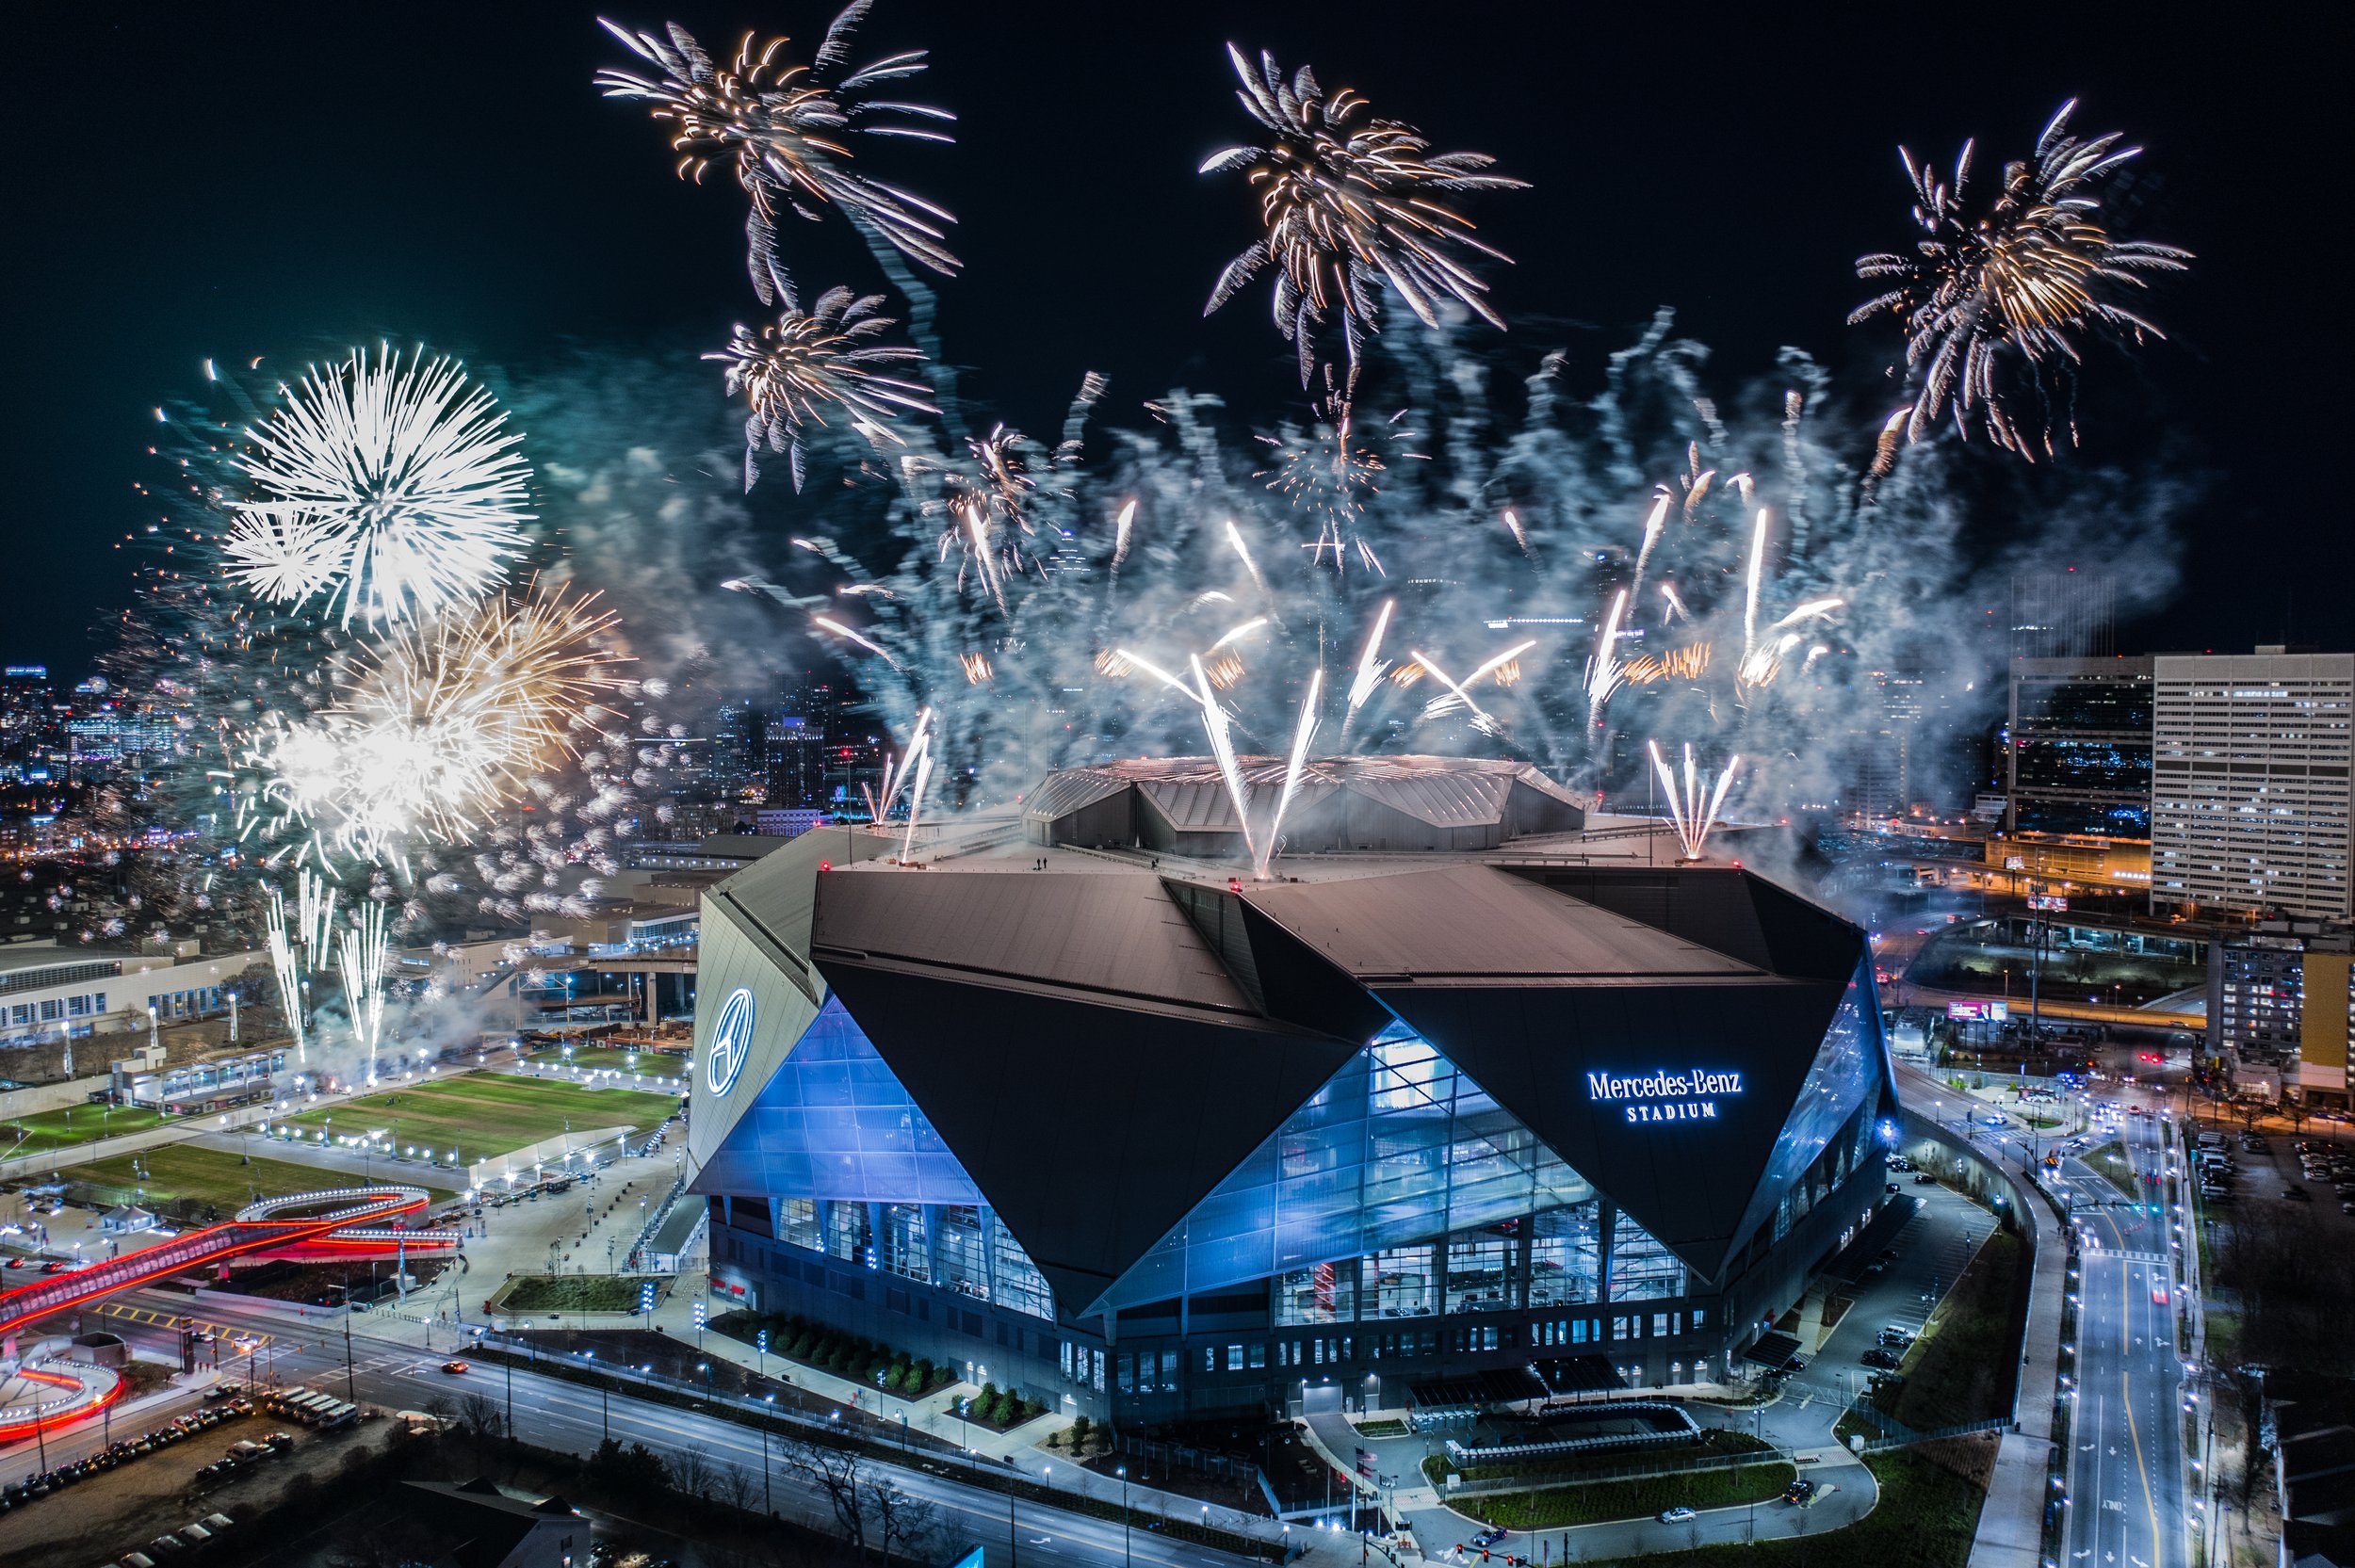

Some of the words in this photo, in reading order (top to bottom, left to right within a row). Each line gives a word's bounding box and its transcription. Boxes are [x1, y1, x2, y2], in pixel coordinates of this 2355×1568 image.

[1587, 1070, 1743, 1100] Mercedes-Benz
[1627, 1102, 1716, 1123] STADIUM
[2102, 1499, 2122, 1511] ONLY
